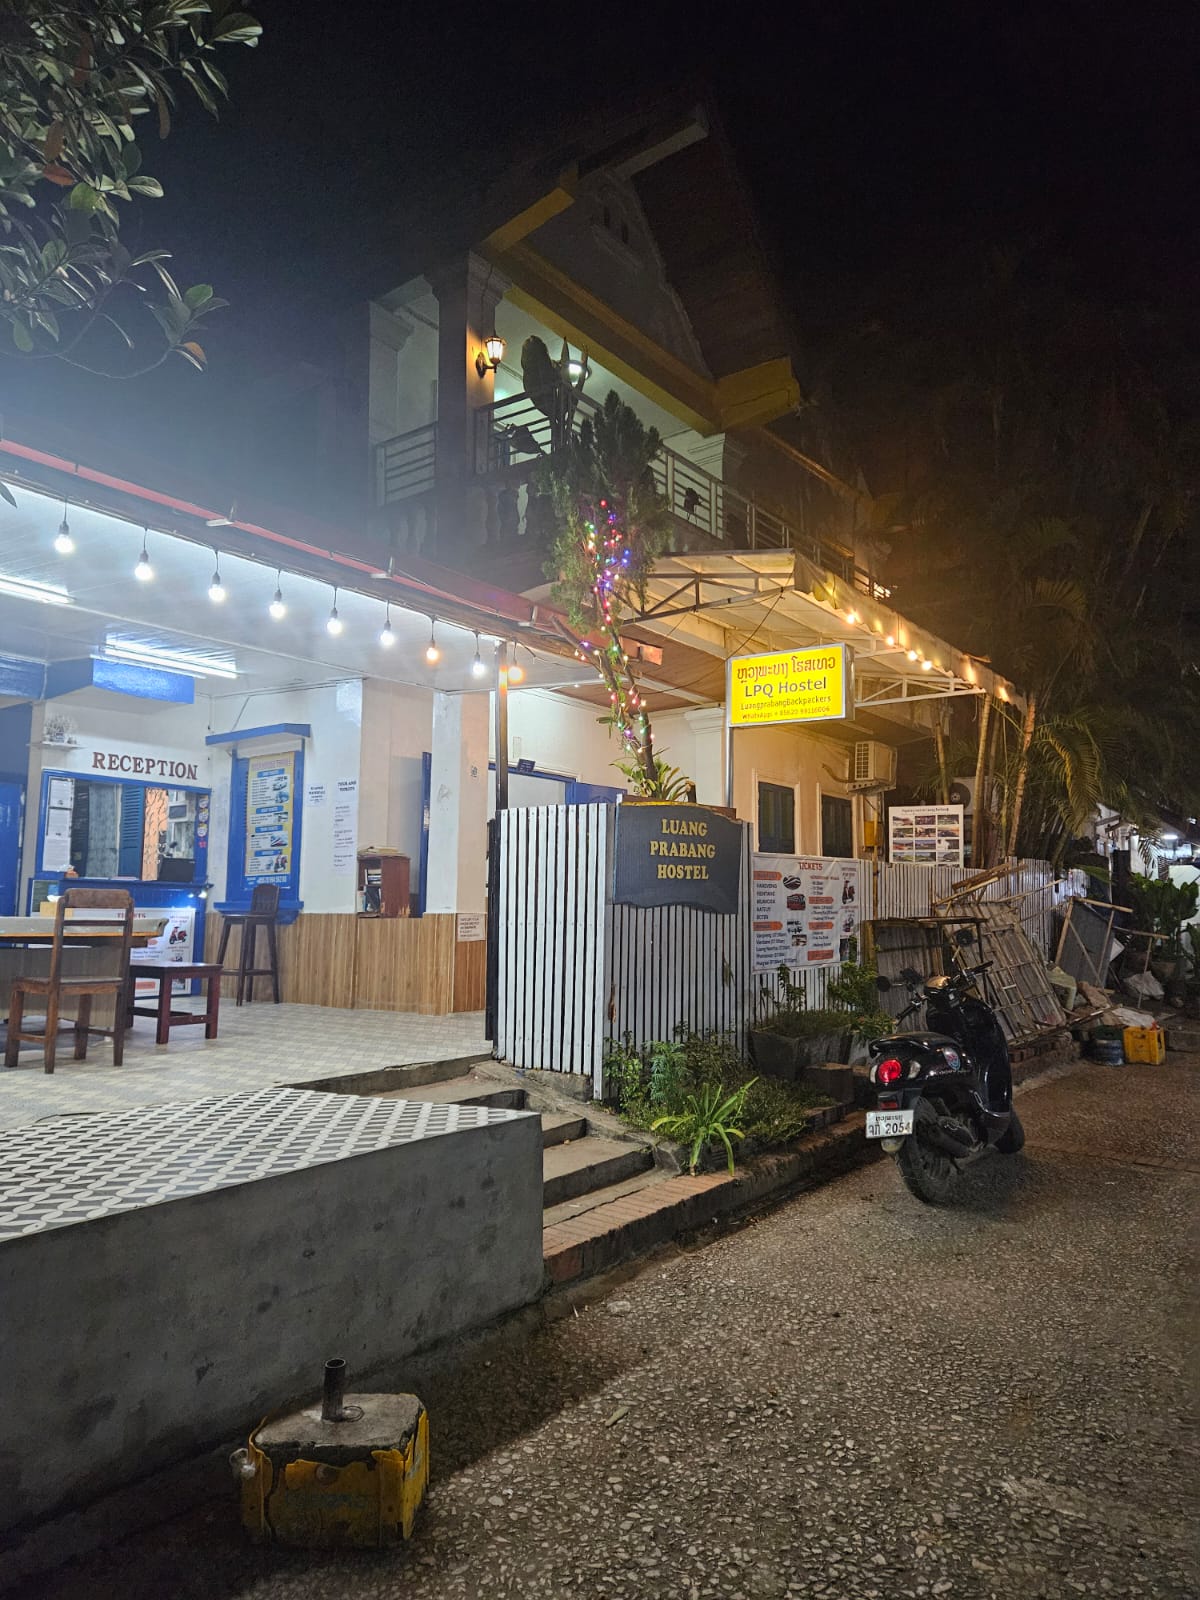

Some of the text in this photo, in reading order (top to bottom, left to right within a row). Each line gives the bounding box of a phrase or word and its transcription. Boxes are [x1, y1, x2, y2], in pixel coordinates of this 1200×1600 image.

[745, 676, 827, 698] LPQ Hostel
[92, 751, 198, 780] RECEPTION
[661, 818, 708, 837] LUANG
[649, 840, 717, 859] PRABANG
[657, 864, 709, 880] HOSTEL
[799, 861, 823, 871] TICKETS
